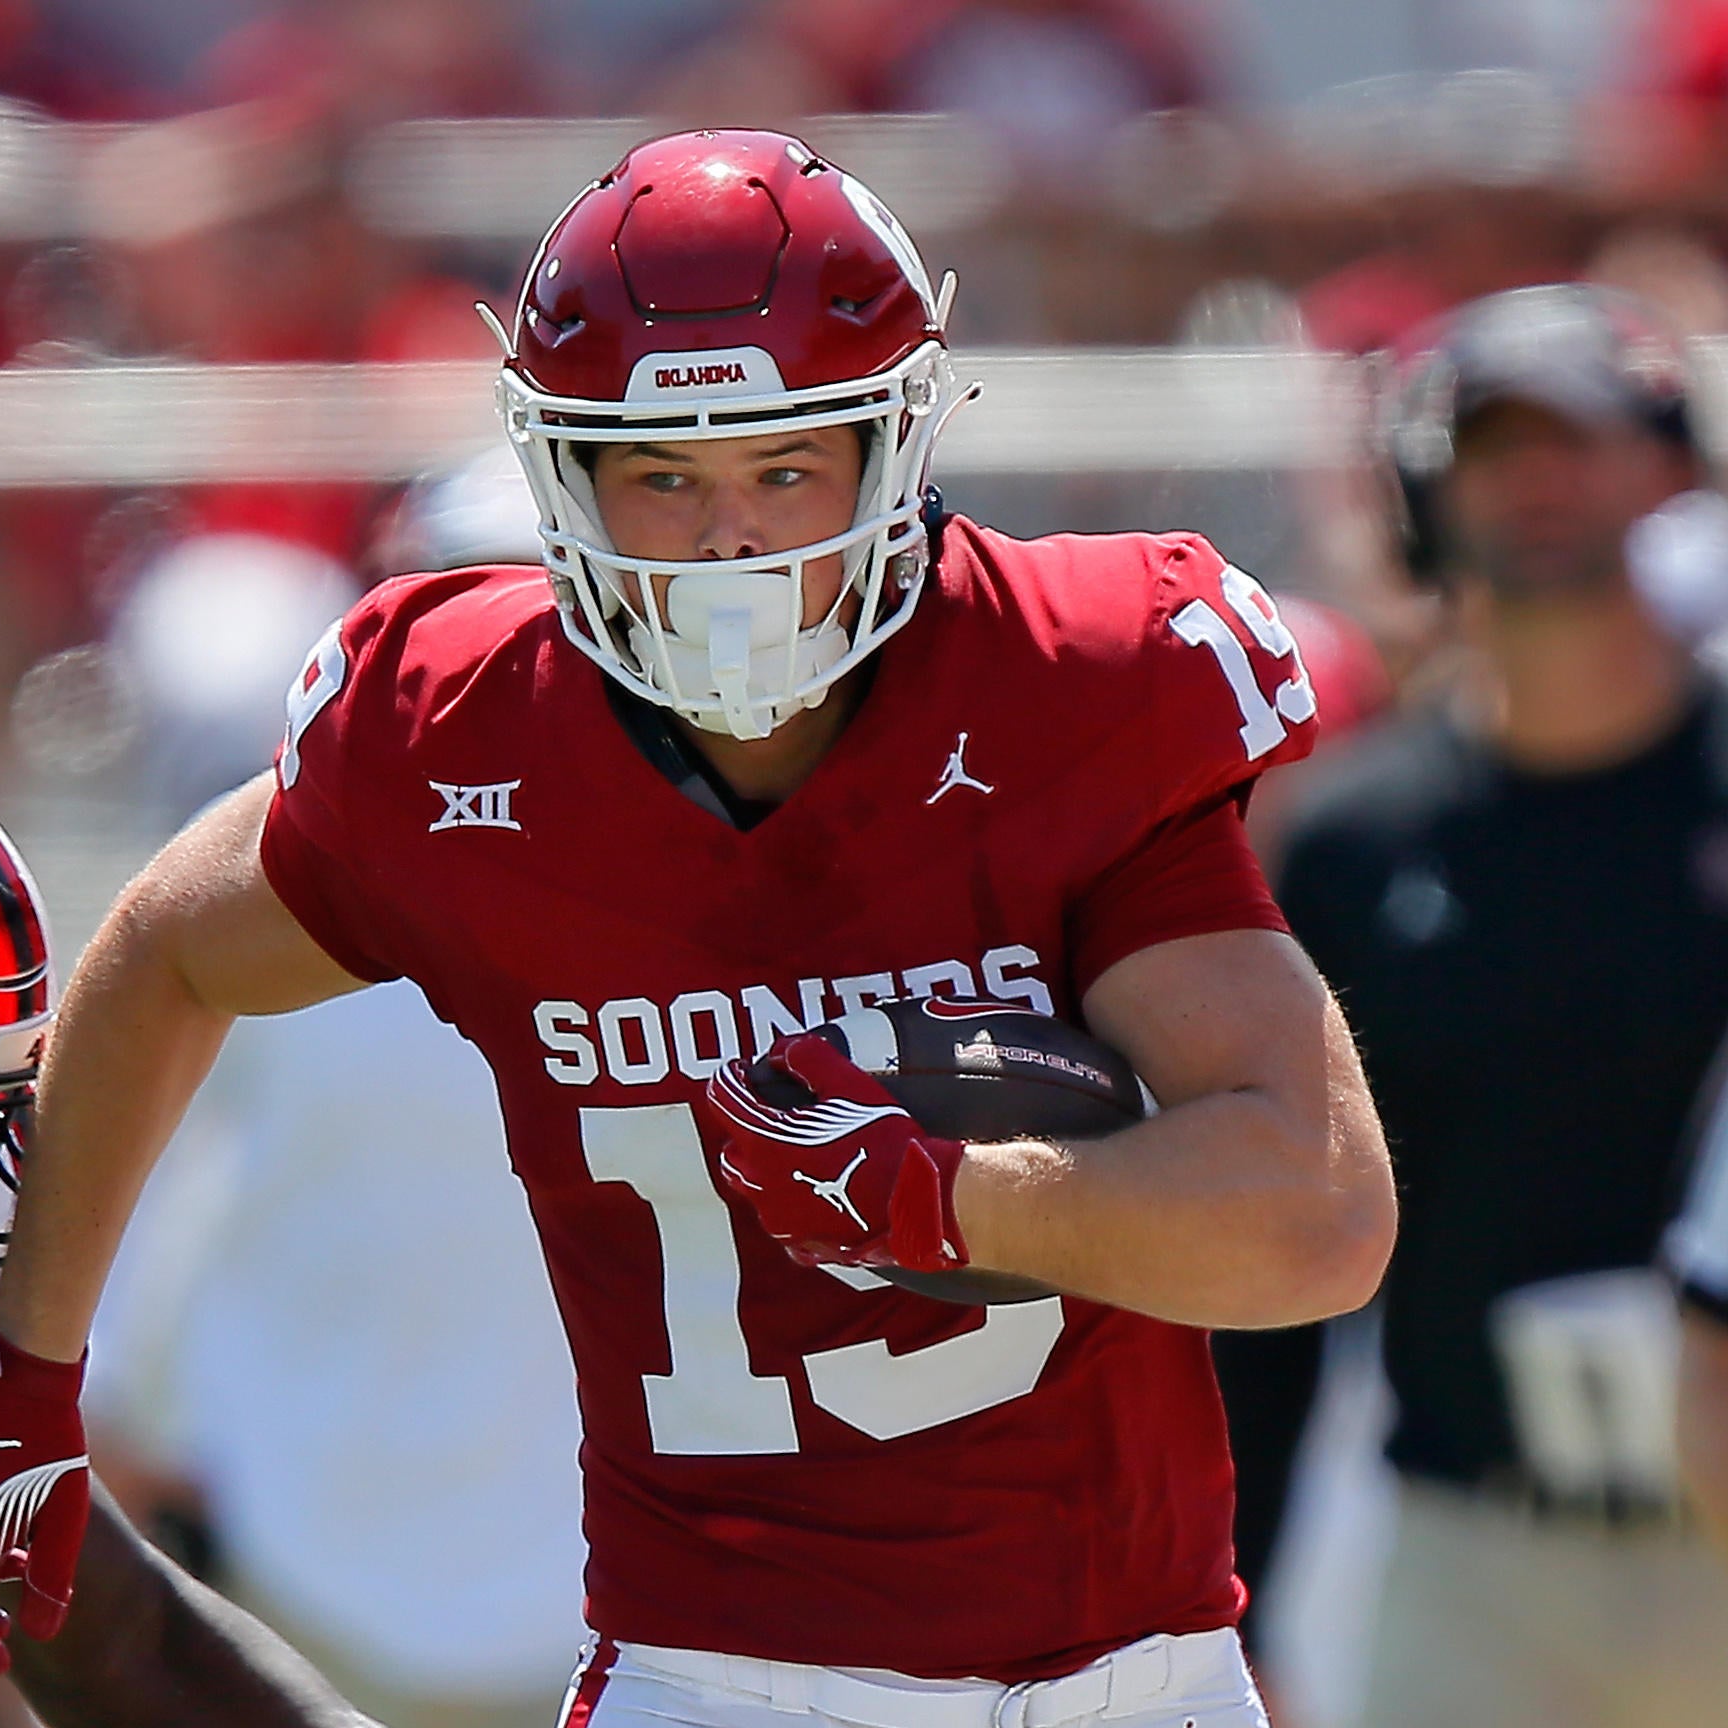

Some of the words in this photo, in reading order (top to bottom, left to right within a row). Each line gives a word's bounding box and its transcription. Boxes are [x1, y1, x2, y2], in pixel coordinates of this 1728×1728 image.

[655, 363, 747, 388] OKLAHOMA
[1168, 564, 1318, 762] 19
[428, 778, 522, 832] XII
